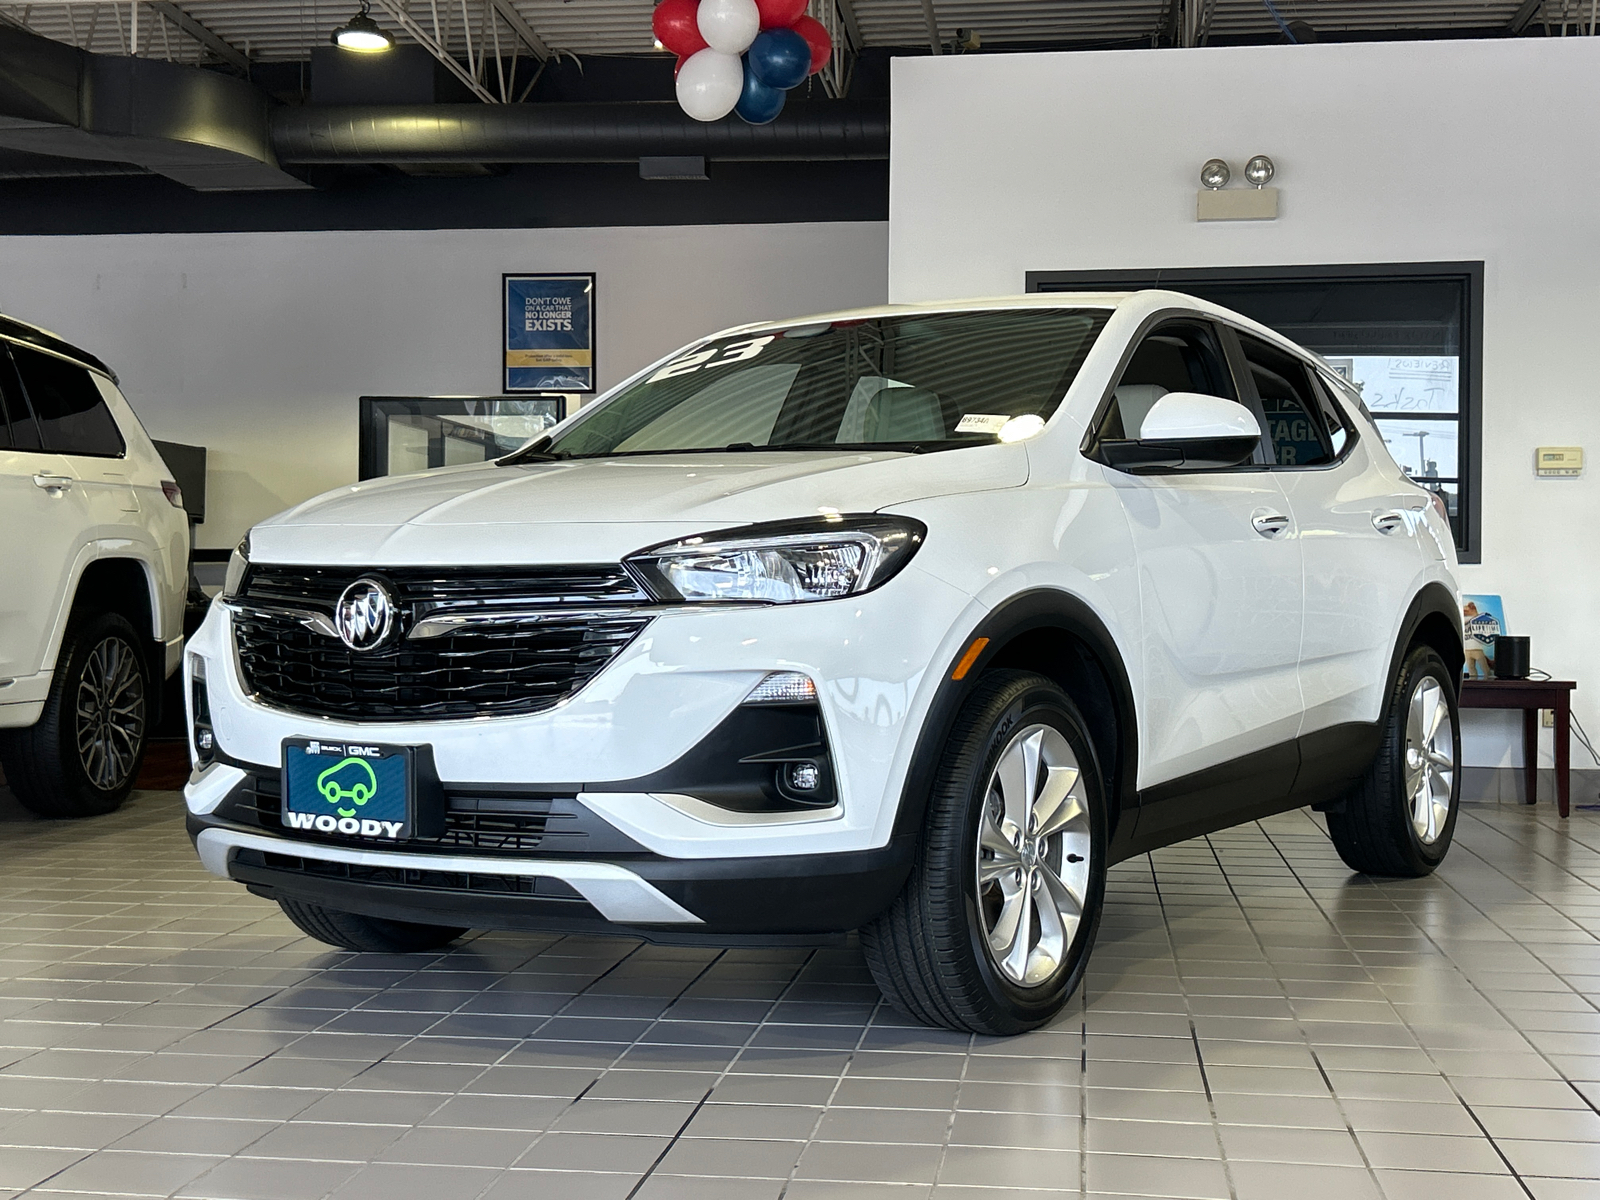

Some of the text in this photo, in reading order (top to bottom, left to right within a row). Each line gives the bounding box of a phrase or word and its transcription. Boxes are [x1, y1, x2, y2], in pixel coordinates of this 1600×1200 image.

[525, 297, 572, 305] DON'T OWE
[525, 311, 572, 319] NO LONGER
[525, 319, 574, 331] EXISTS.
[321, 745, 380, 757] BUICK GMC
[287, 811, 404, 838] WOODY
